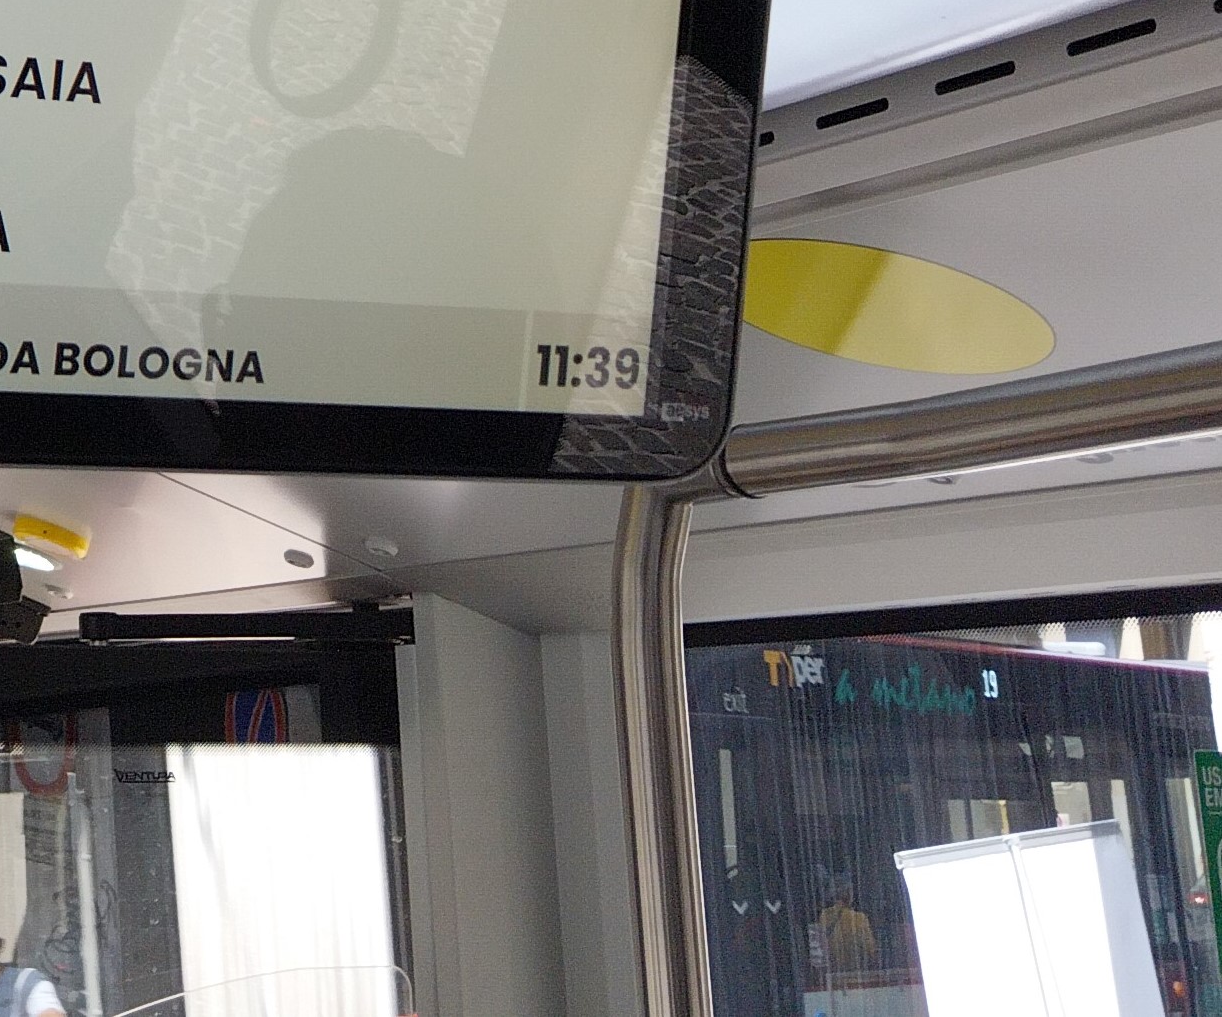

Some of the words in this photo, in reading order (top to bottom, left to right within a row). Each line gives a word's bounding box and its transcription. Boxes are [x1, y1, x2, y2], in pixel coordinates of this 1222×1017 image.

[54, 342, 265, 384] BOLOGNA
[536, 344, 641, 389] 11:39
[114, 769, 176, 783] VENTURA
